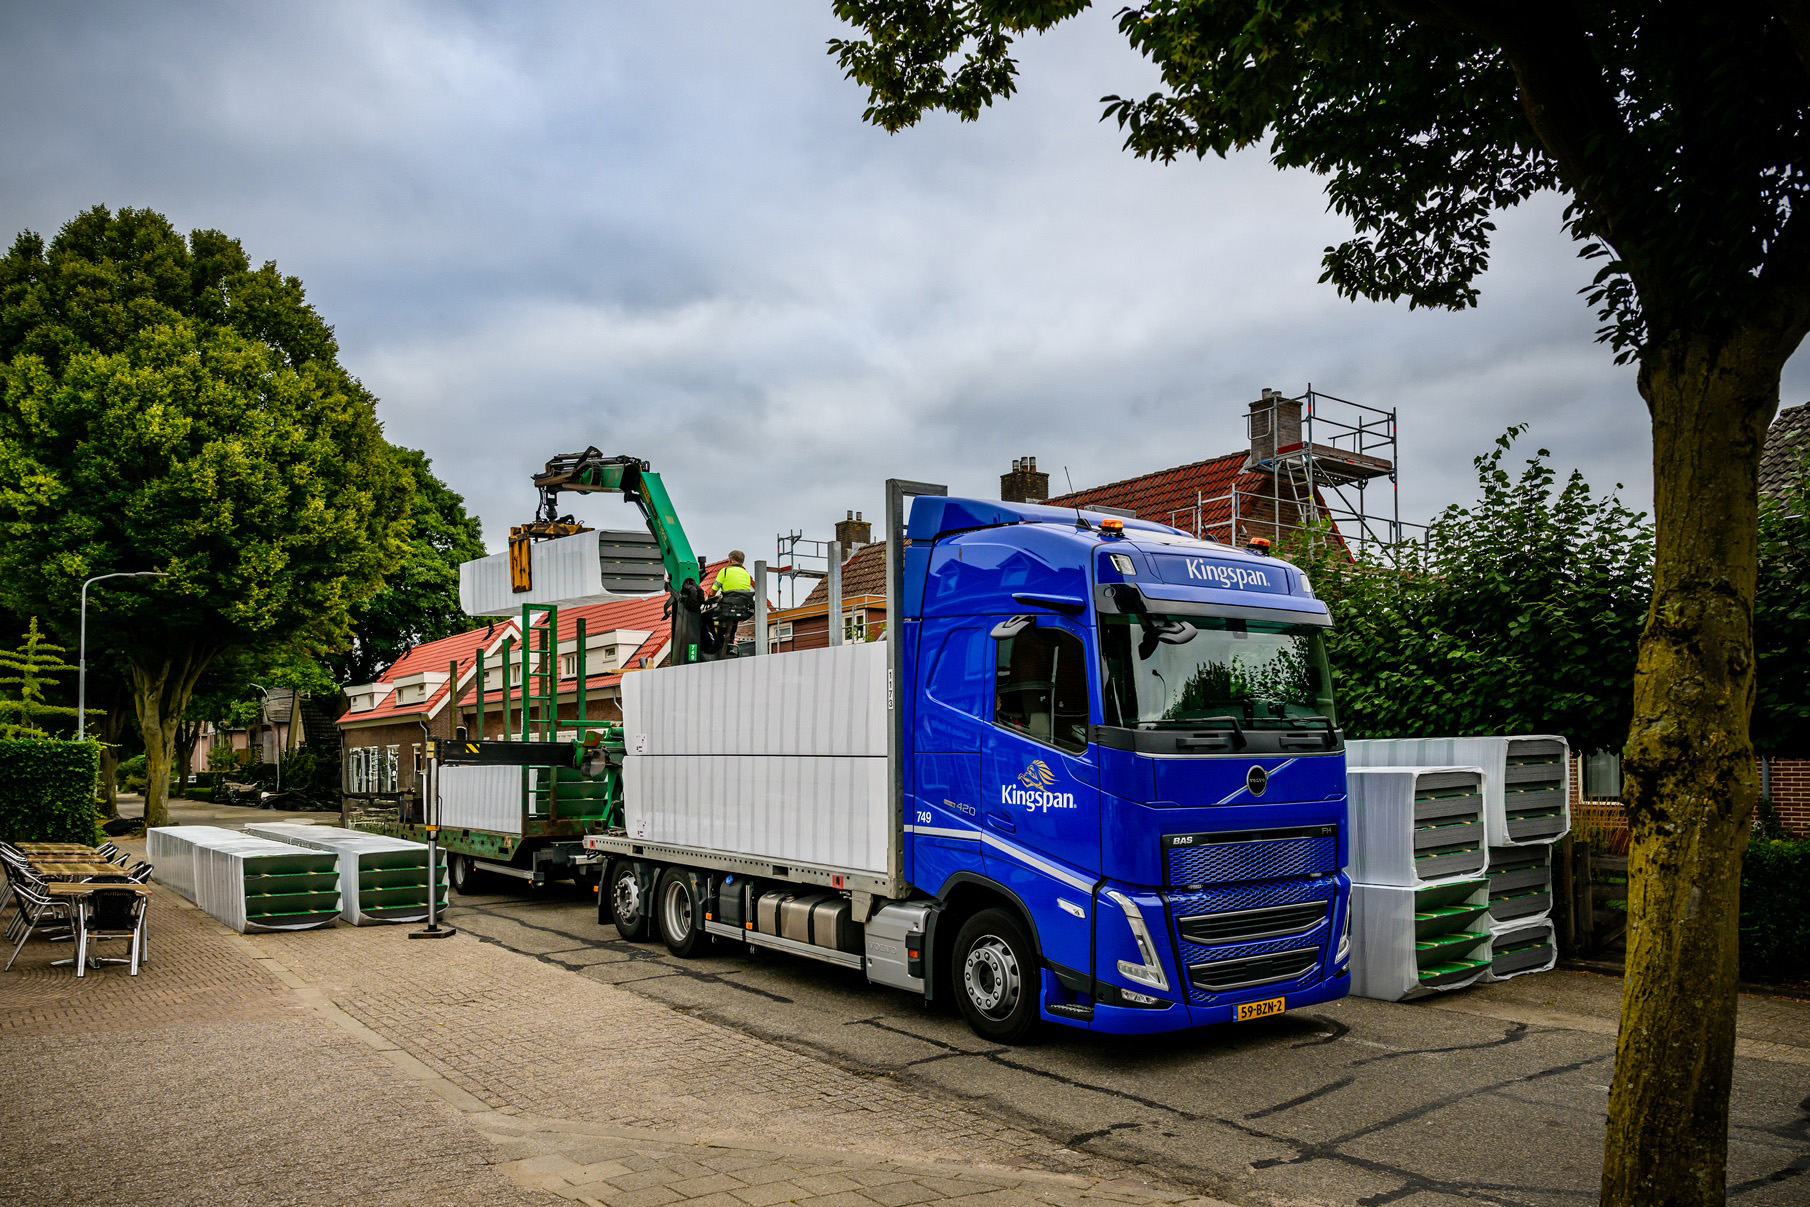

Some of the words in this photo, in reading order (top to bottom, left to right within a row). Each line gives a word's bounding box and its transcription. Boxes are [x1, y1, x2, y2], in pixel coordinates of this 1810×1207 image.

[1185, 559, 1268, 589] Kingspan
[1001, 784, 1074, 813] Kingspan
[956, 802, 976, 817] 420
[916, 811, 932, 824] 749
[1321, 827, 1332, 835] FH
[1172, 836, 1193, 845] BAS
[1241, 1000, 1283, 1019] 59-BZN-2
